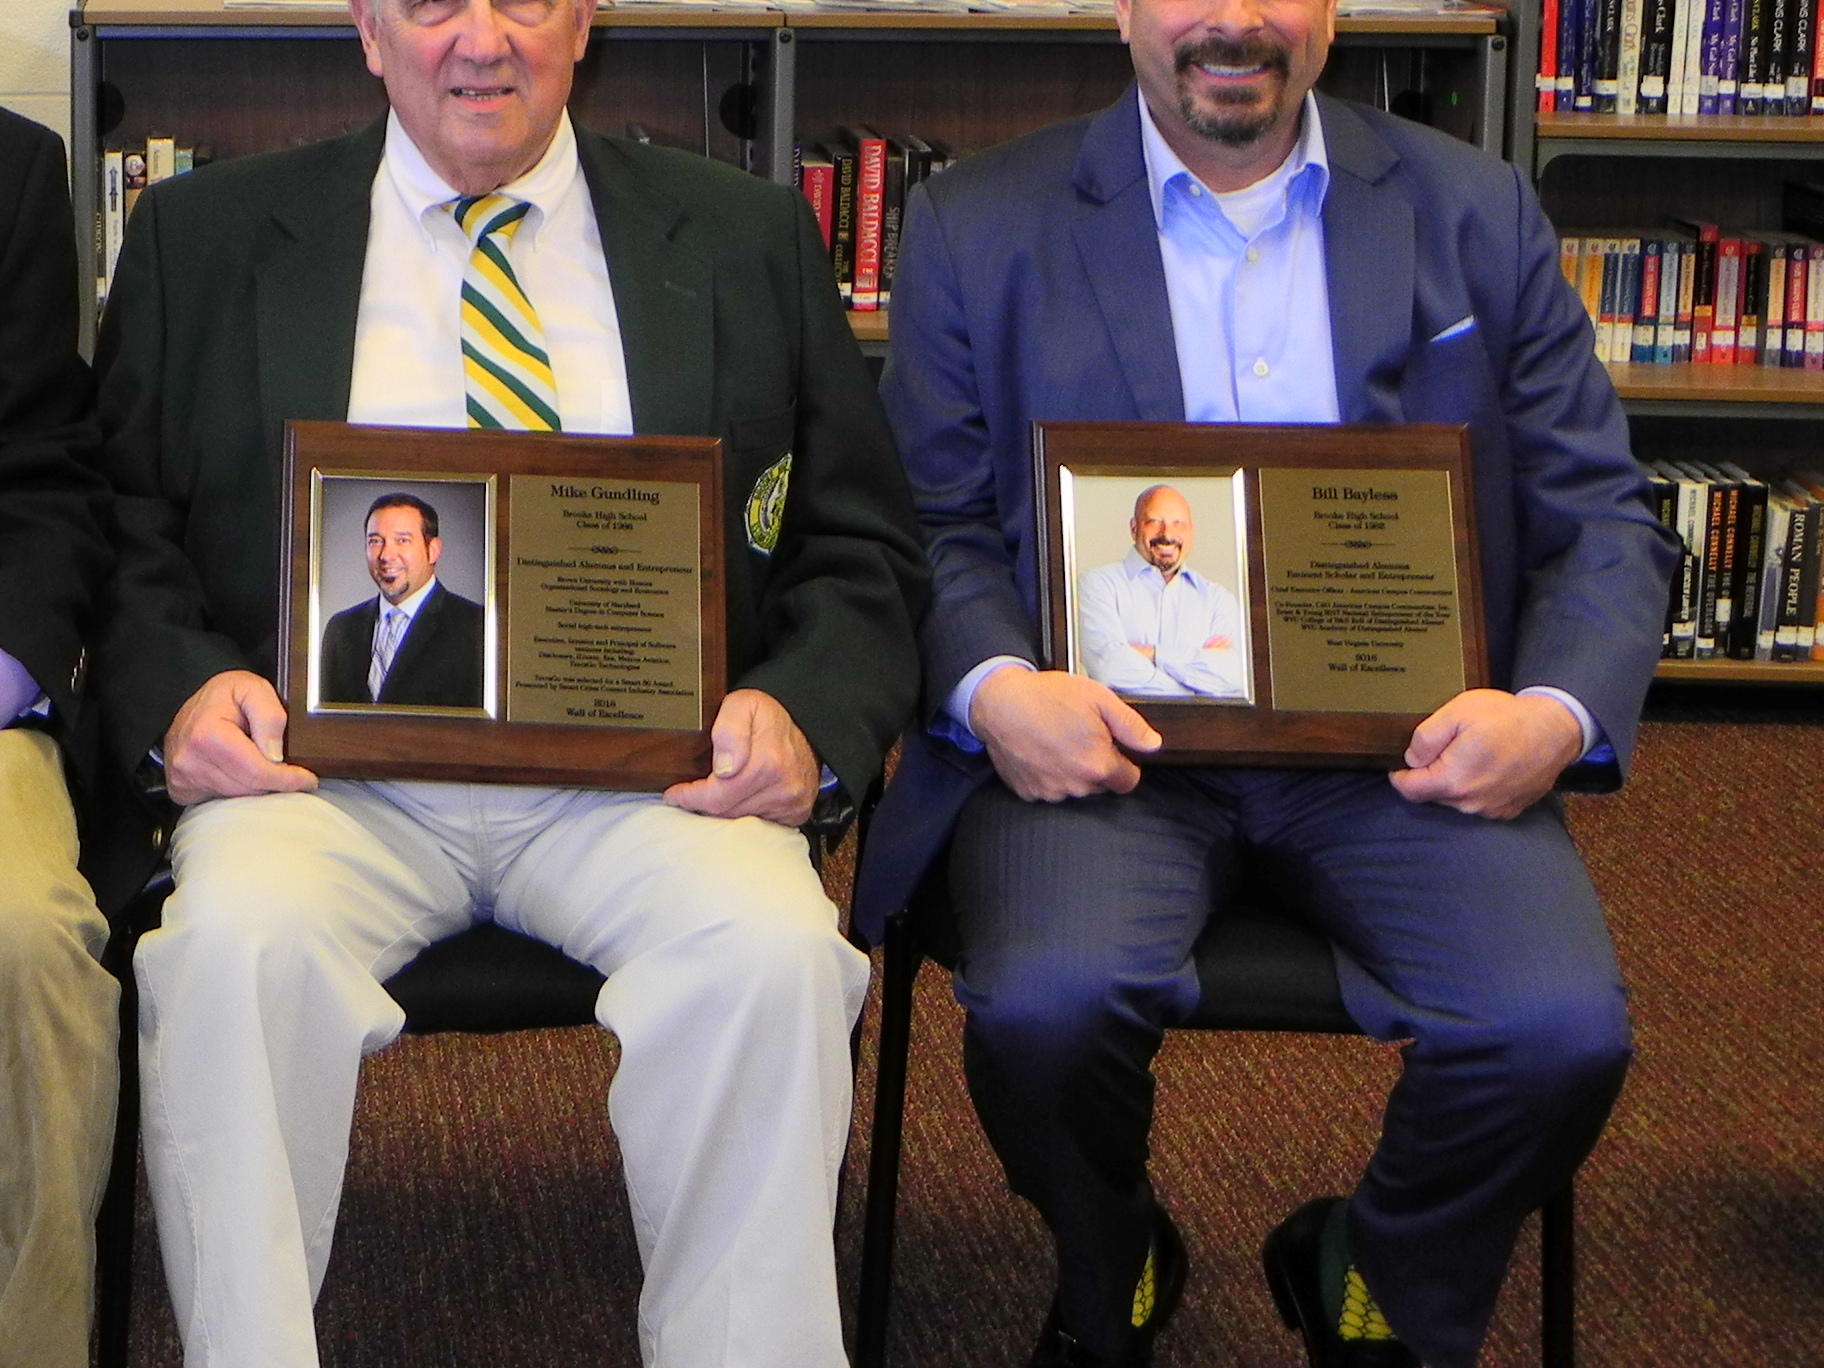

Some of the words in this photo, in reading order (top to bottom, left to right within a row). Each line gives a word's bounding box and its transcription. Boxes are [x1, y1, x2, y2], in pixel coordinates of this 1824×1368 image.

[1655, 7, 1666, 33] Clark
[1772, 20, 1783, 52] CLARK
[1797, 20, 1808, 52] CLARK
[841, 159, 853, 185] DAVID
[864, 145, 881, 190] DAVID
[860, 193, 880, 263] BALDACCI
[886, 207, 900, 230] SHIP
[551, 485, 587, 498] Mike
[591, 487, 660, 505] Gundling
[1312, 487, 1338, 499] Bill
[1343, 488, 1398, 503] Bayless
[1711, 491, 1722, 527] MICHAEL
[1727, 490, 1739, 524] MICHAEL
[595, 511, 616, 520] High
[619, 512, 647, 521] School
[1346, 512, 1367, 521] High
[1369, 512, 1398, 521] School
[1708, 530, 1719, 571] CONNELLY
[1724, 528, 1735, 569] CONNELLY
[1791, 514, 1806, 562] ROMAN
[1785, 568, 1800, 616] PEOPLE
[588, 709, 596, 717] of
